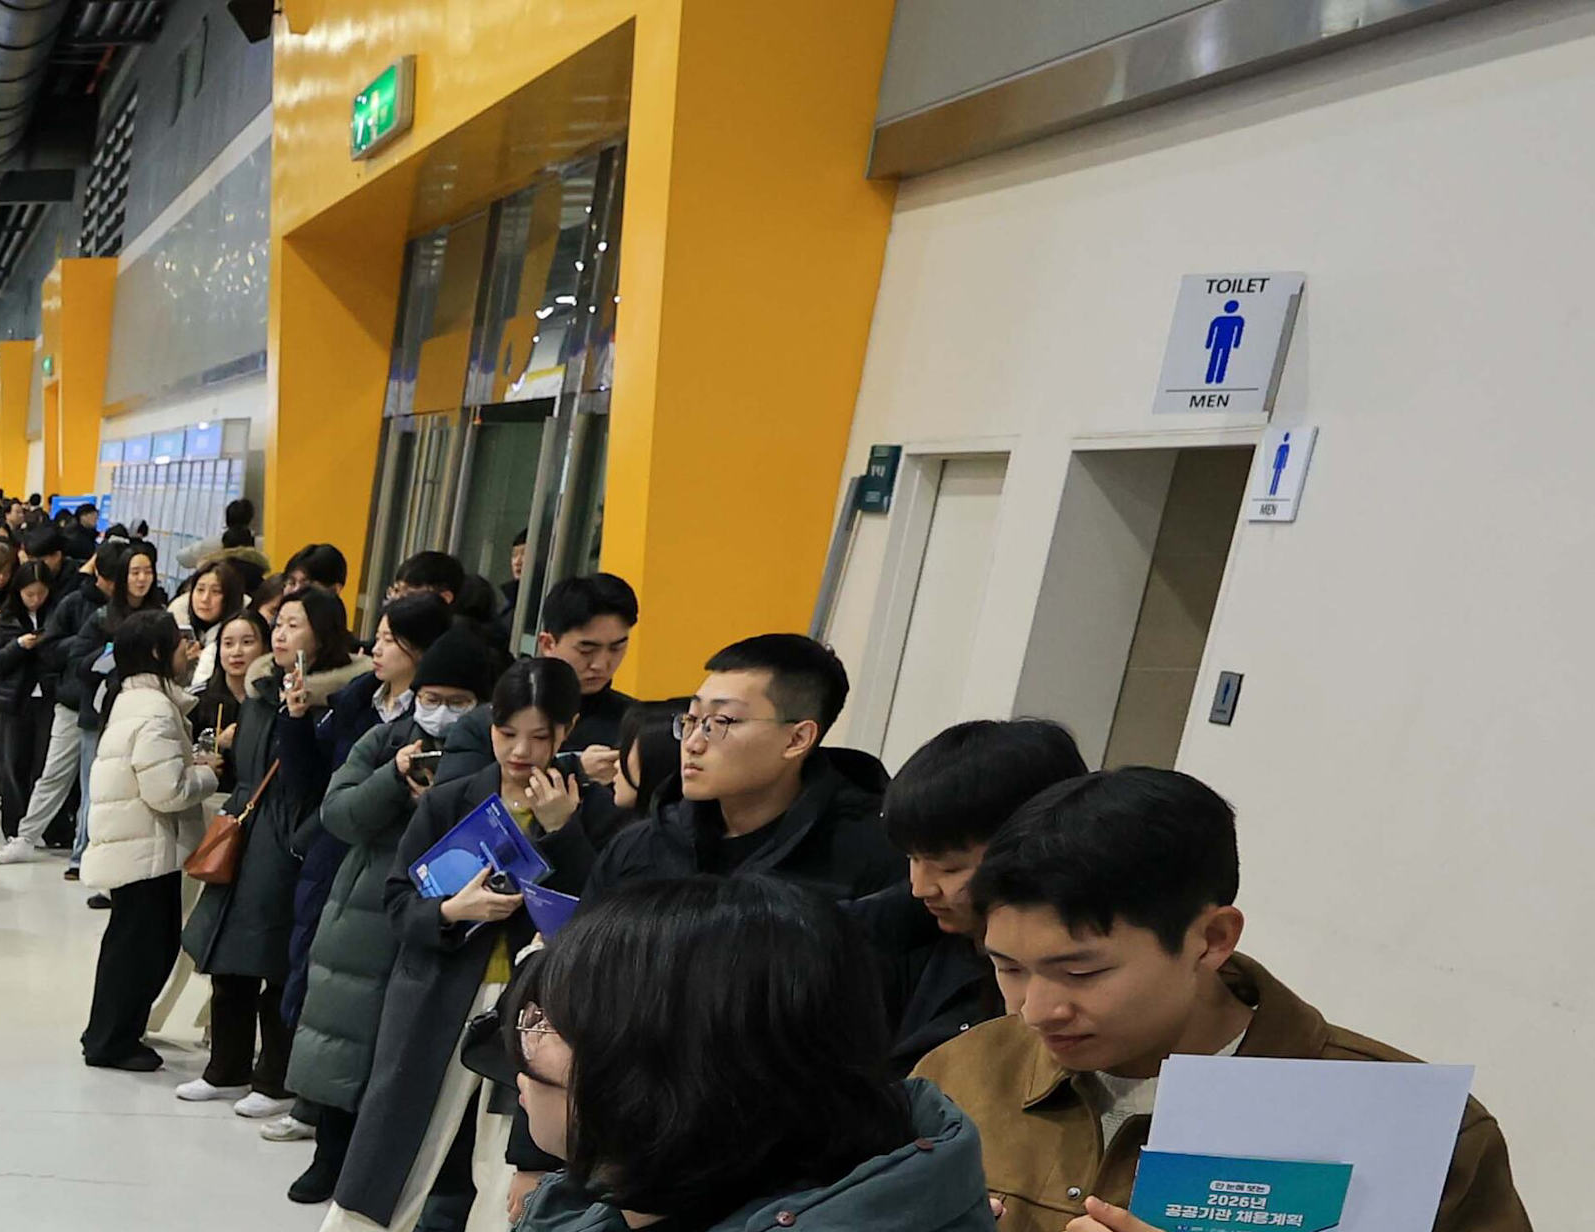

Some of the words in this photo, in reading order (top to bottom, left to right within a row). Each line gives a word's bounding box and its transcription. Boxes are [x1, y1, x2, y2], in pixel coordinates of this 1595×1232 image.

[1206, 278, 1269, 294] TOILET
[1189, 394, 1230, 408] MEN
[1259, 503, 1277, 516] MEN
[1207, 1193, 1266, 1210] 2026년
[1165, 1203, 1232, 1222] 공공기관
[1235, 1208, 1303, 1227] 채용계획
